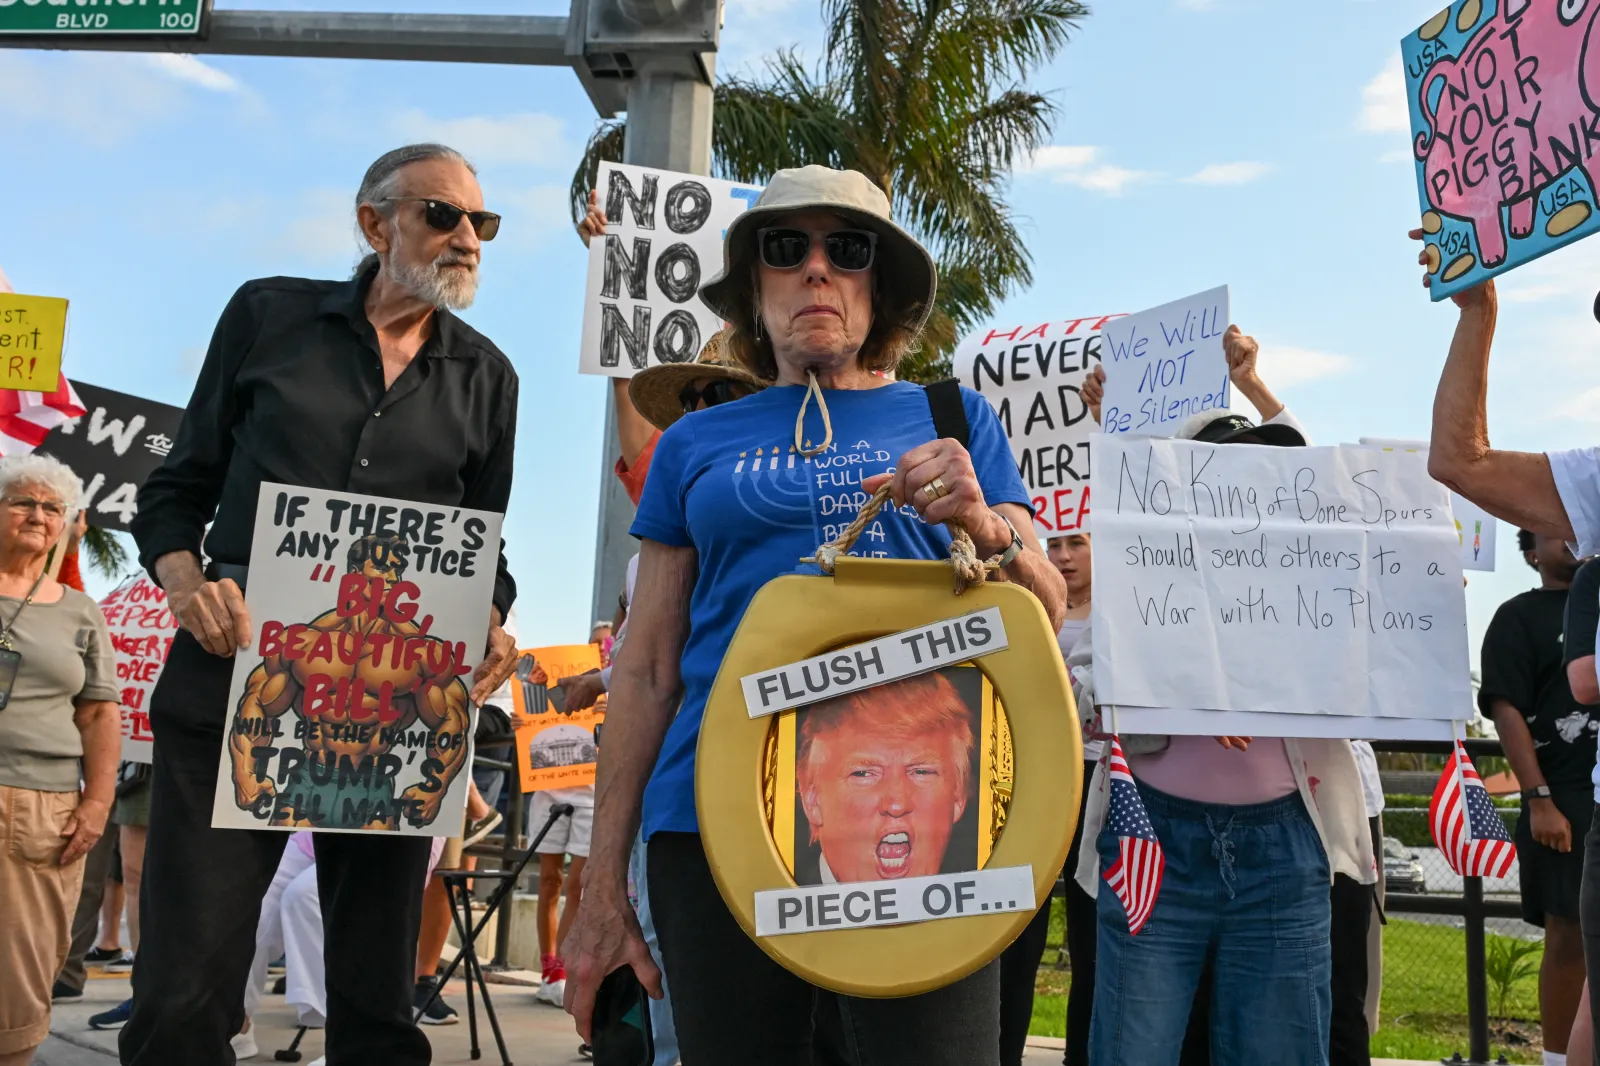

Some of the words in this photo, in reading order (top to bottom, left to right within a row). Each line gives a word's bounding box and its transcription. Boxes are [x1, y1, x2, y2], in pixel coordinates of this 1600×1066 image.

[56, 13, 109, 28] BLVD
[160, 13, 194, 28] 100
[1408, 37, 1449, 79] USA
[1448, 18, 1523, 111] NOT
[1436, 55, 1542, 158] YOUR
[1430, 100, 1542, 206] PIGGY
[1498, 112, 1600, 201] BANK
[604, 168, 713, 235] NO
[1540, 177, 1586, 217] USA
[1438, 230, 1471, 254] USA
[599, 233, 702, 304] NO
[0, 309, 29, 325] ST.
[0, 327, 43, 351] ent.
[599, 301, 701, 370] NO
[973, 335, 1102, 391] NEVER
[1106, 325, 1149, 362] We
[1138, 350, 1195, 394] NOT
[1104, 408, 1131, 434] Be
[814, 450, 891, 469] WORLD
[851, 440, 871, 450] A
[1018, 441, 1091, 490] MERI
[815, 467, 864, 489] FULL
[1117, 446, 1172, 517] No
[1190, 448, 1261, 535] King
[1267, 486, 1292, 516] of
[1294, 467, 1350, 524] Bone
[1352, 469, 1433, 530] Spurs
[274, 491, 310, 528] IF
[325, 498, 487, 551] THERE'S
[1031, 485, 1091, 531] REA
[276, 530, 340, 561] ANY
[350, 535, 478, 578] JUSTICE
[865, 521, 886, 542] A
[1125, 533, 1199, 572] should
[1211, 533, 1268, 569] send
[1280, 535, 1362, 571] others
[1372, 549, 1402, 576] to
[1427, 561, 1446, 576] a
[309, 563, 434, 637] "BIG,
[1133, 583, 1197, 627] War
[1220, 586, 1280, 625] with
[1297, 585, 1334, 629] No
[1333, 587, 1434, 634] Plans
[116, 659, 160, 682] OPLE
[257, 620, 473, 675] BEAUTIFUL
[757, 646, 885, 708] FLUSH
[901, 615, 993, 665] THIS
[235, 716, 285, 740] WILL
[293, 719, 320, 741] BE
[331, 723, 372, 742] THE
[250, 745, 446, 793] TRUMP'S
[582, 768, 597, 776] HOU
[251, 793, 326, 821] CELL
[341, 797, 426, 827] MATE
[778, 888, 899, 930] PIECE
[922, 880, 1017, 916] OF...
